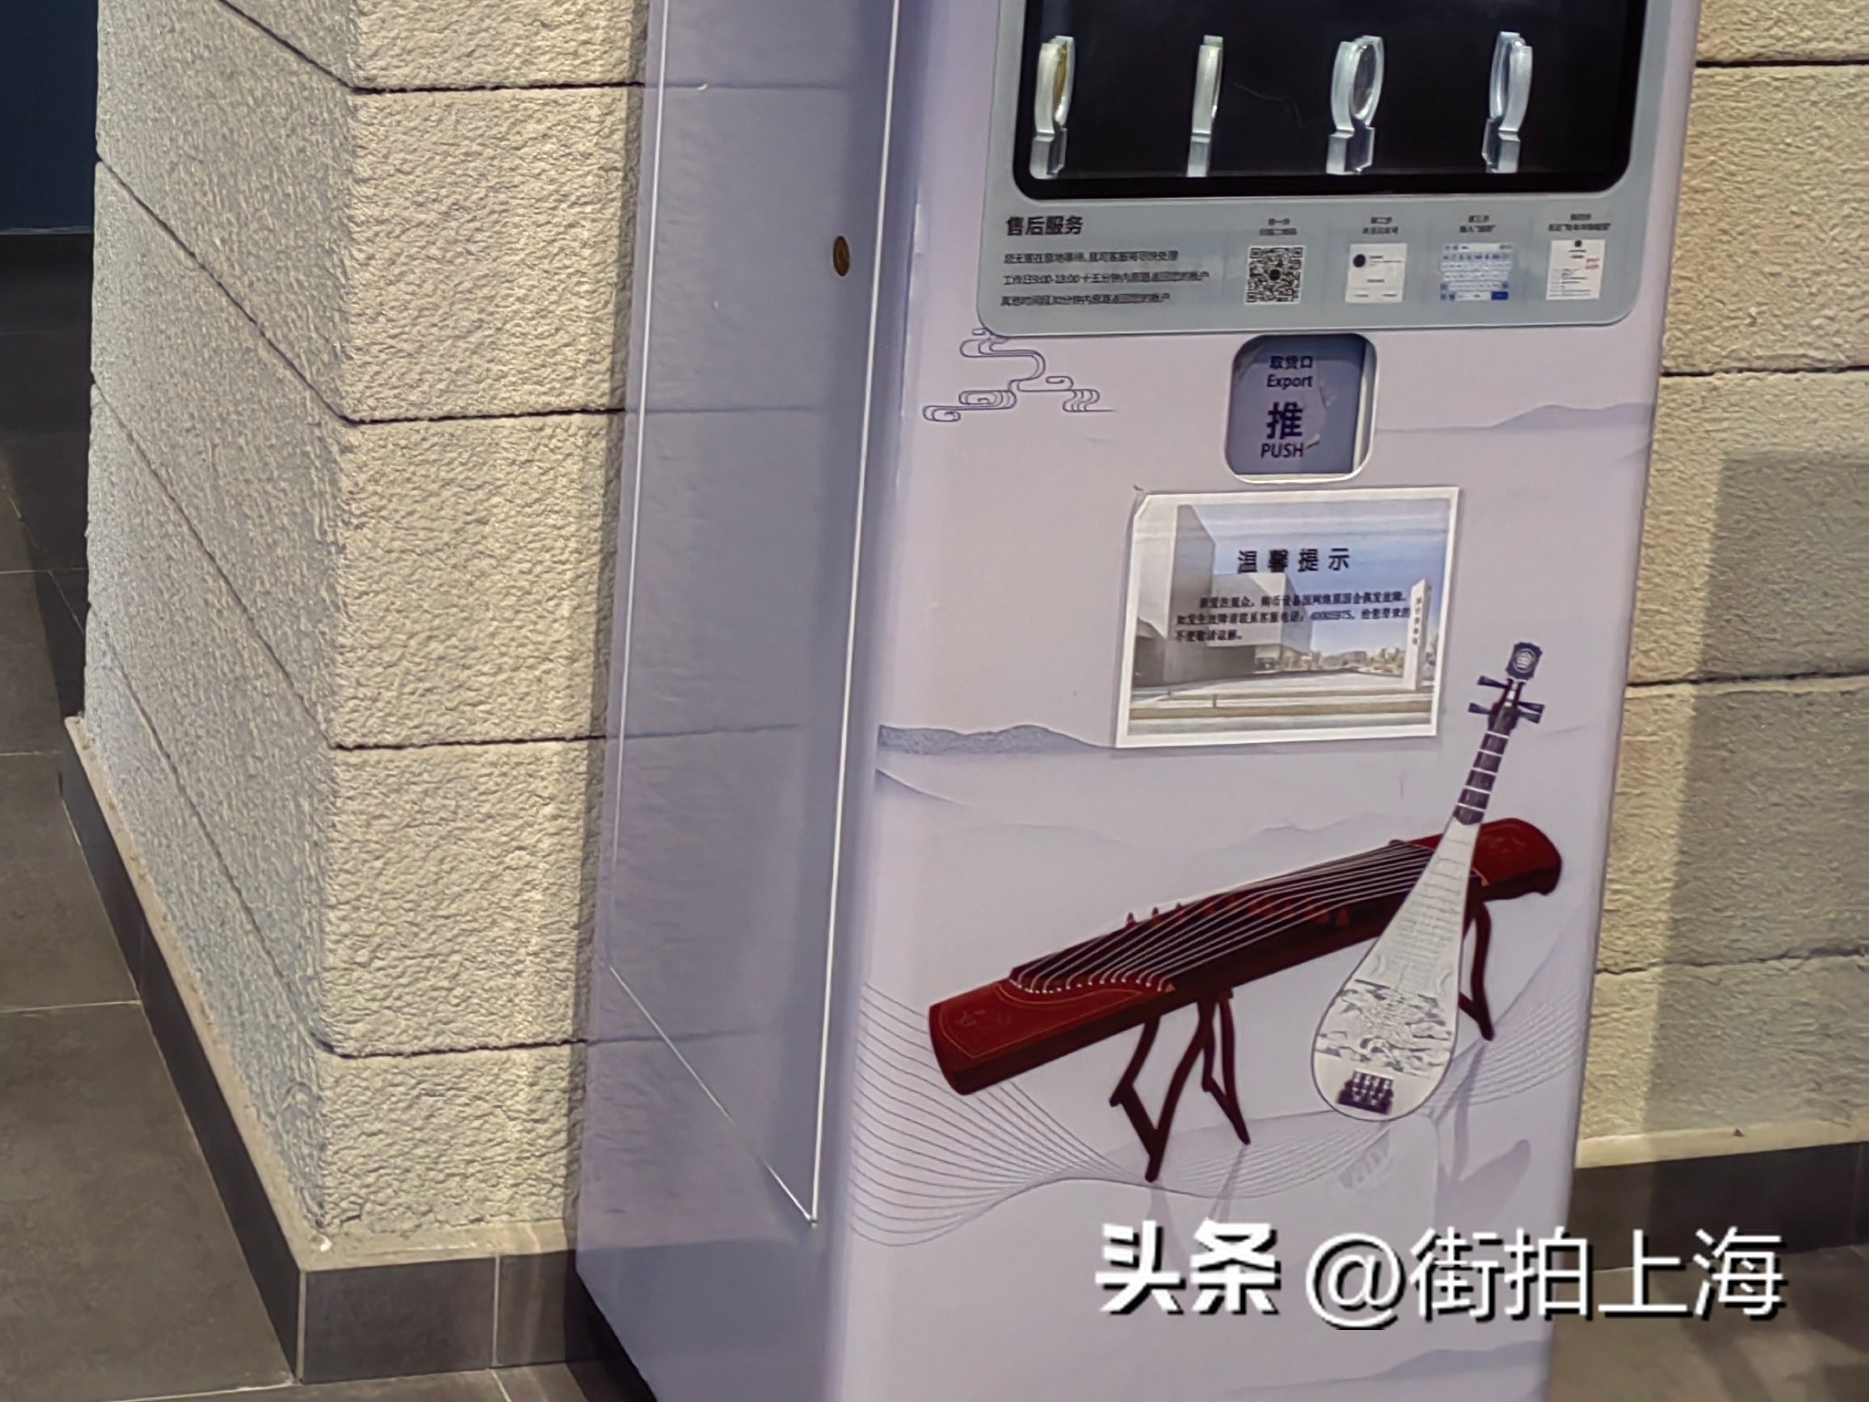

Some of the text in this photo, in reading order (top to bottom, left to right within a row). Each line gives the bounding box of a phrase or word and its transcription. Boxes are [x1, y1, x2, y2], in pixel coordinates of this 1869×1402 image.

[1007, 216, 1083, 236] 售后服务
[1266, 373, 1314, 391] Export
[1266, 401, 1304, 440] 推
[1260, 442, 1305, 459] PUSH
[1237, 547, 1351, 574] 温馨提示
